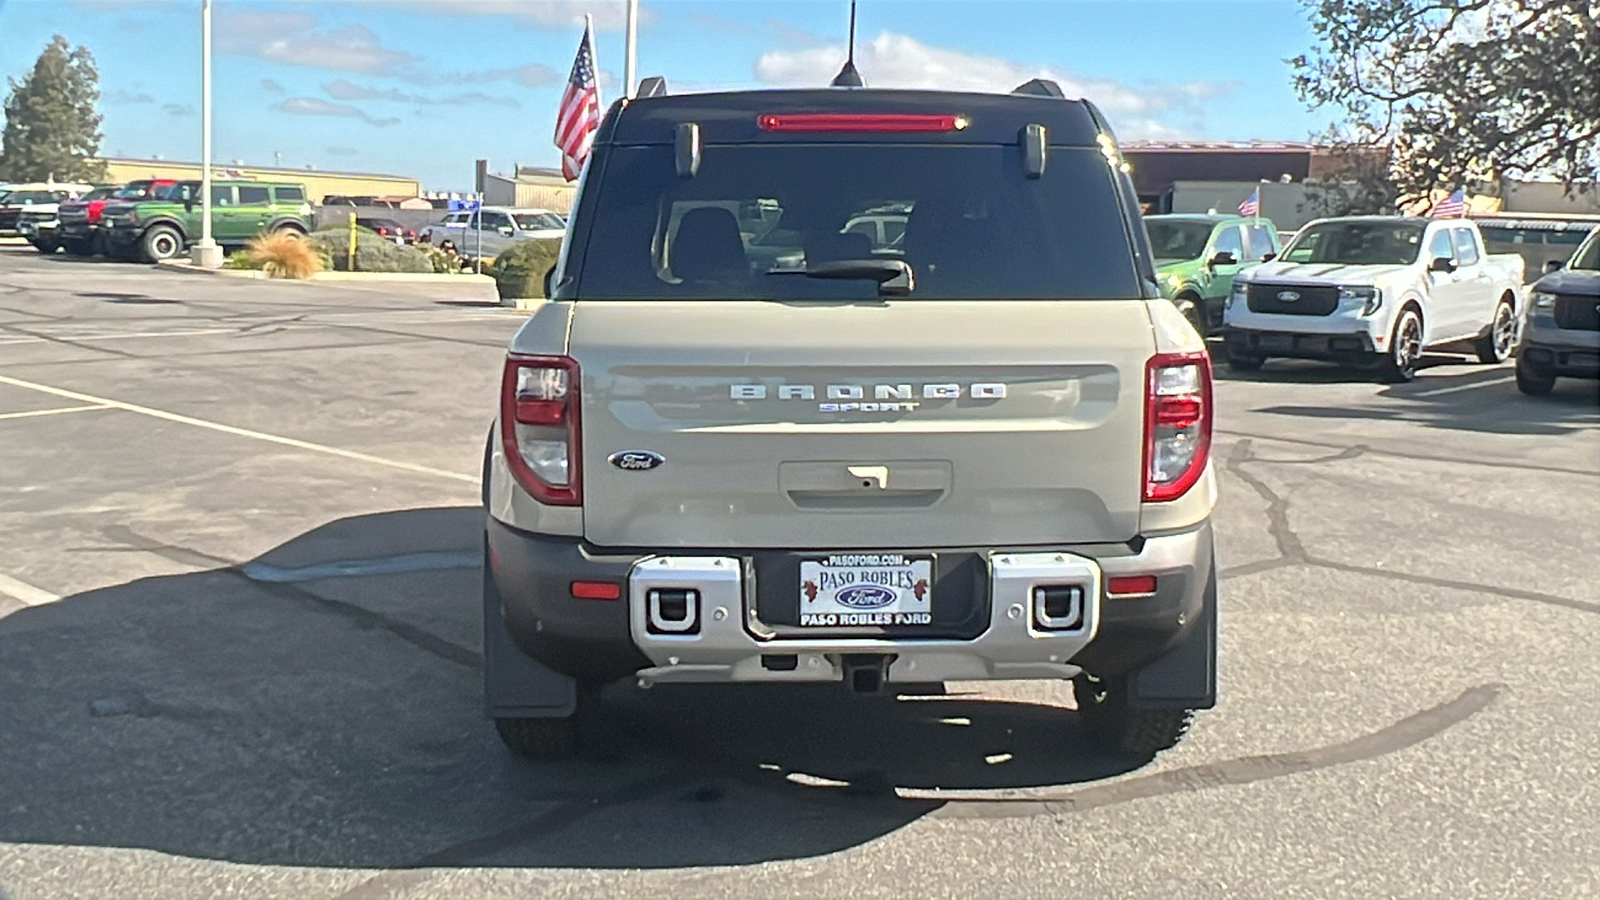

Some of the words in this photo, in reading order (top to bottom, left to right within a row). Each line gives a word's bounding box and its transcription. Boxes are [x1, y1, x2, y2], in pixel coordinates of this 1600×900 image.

[730, 383, 1007, 400] BRONCO
[819, 402, 920, 412] SPORT
[620, 454, 653, 469] Ford
[829, 555, 903, 566] PASOFORD.COM
[820, 571, 855, 590] PASO
[860, 571, 913, 589] ROBLES
[848, 589, 885, 604] Ford
[801, 614, 837, 626] PASO
[840, 613, 892, 625] ROBLES
